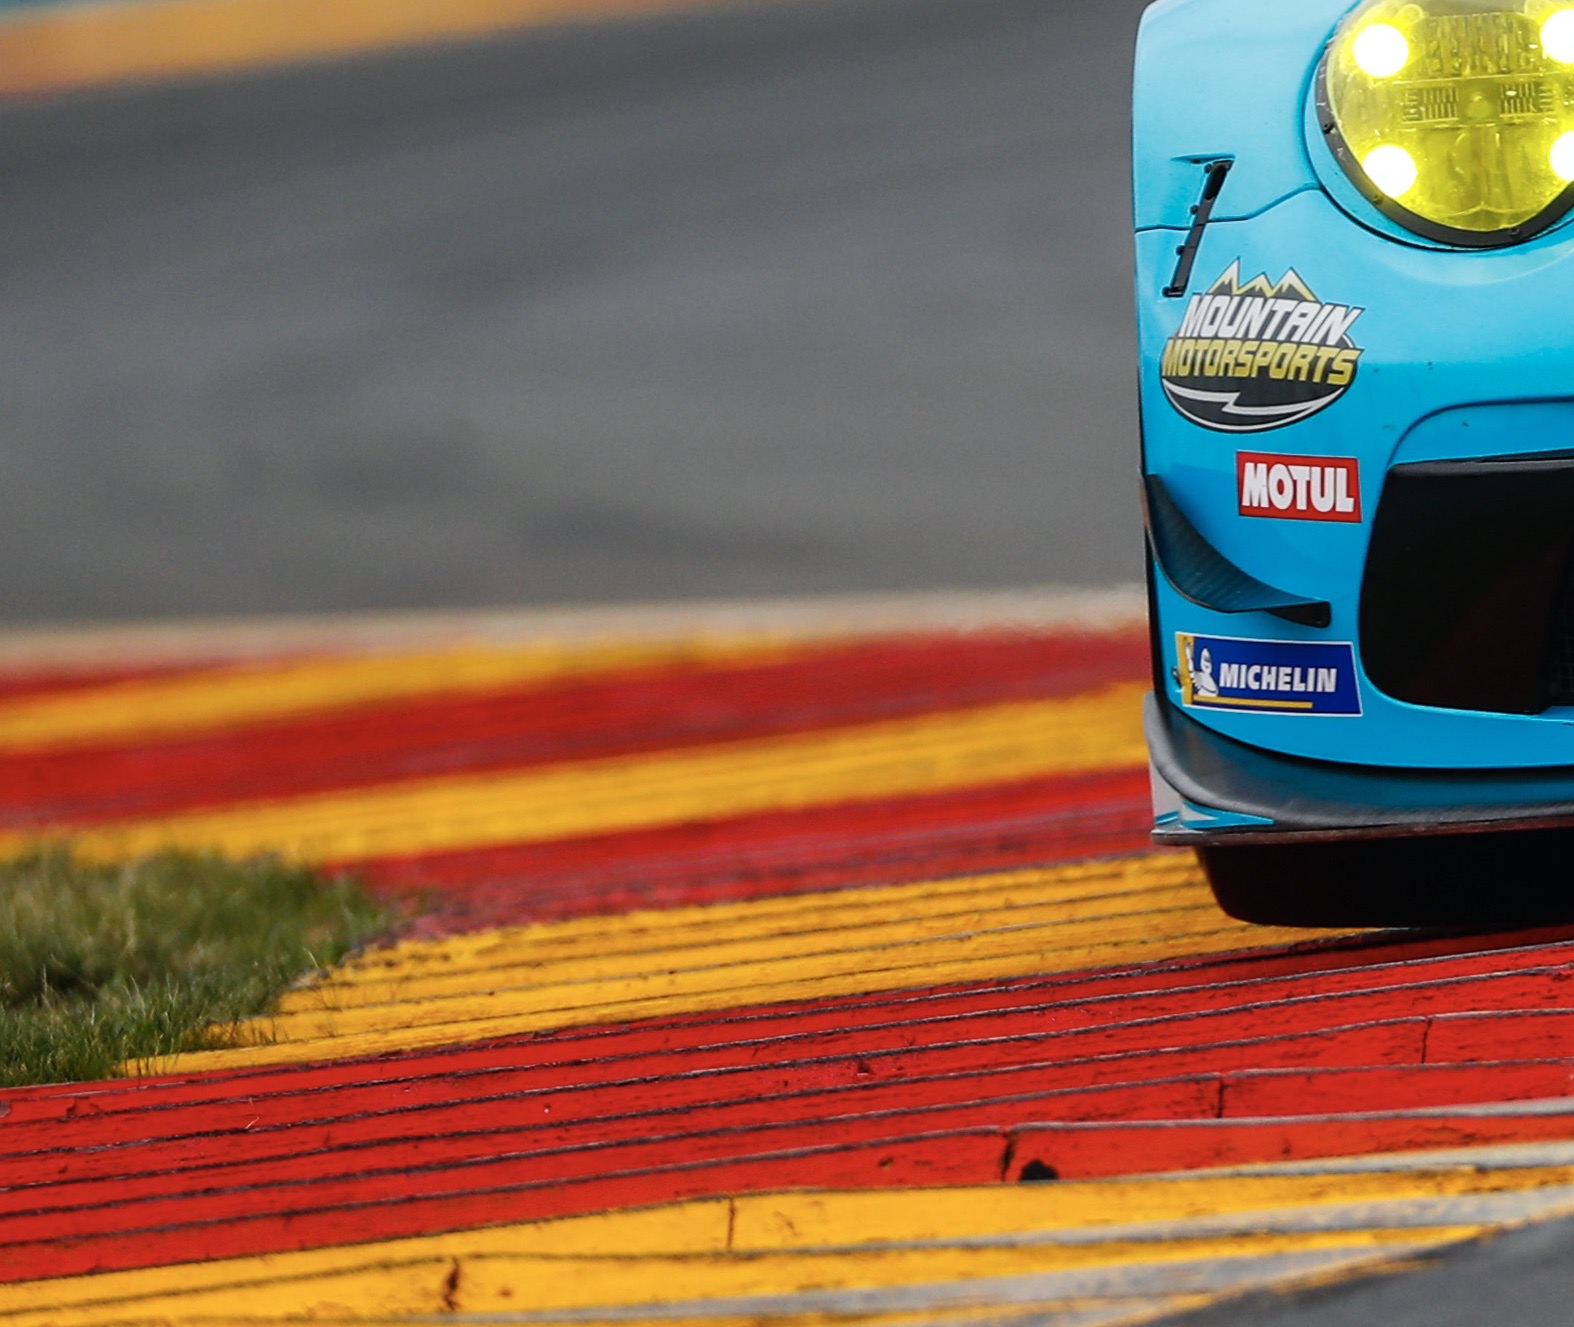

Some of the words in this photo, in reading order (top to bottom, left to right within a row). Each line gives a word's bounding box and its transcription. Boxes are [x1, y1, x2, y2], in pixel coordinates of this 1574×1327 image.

[1177, 291, 1365, 343] MOUNTAIN
[1161, 337, 1363, 387] MOTORSPORTS
[1241, 461, 1355, 514] MOTUL
[1218, 661, 1338, 694] MICHELIN
